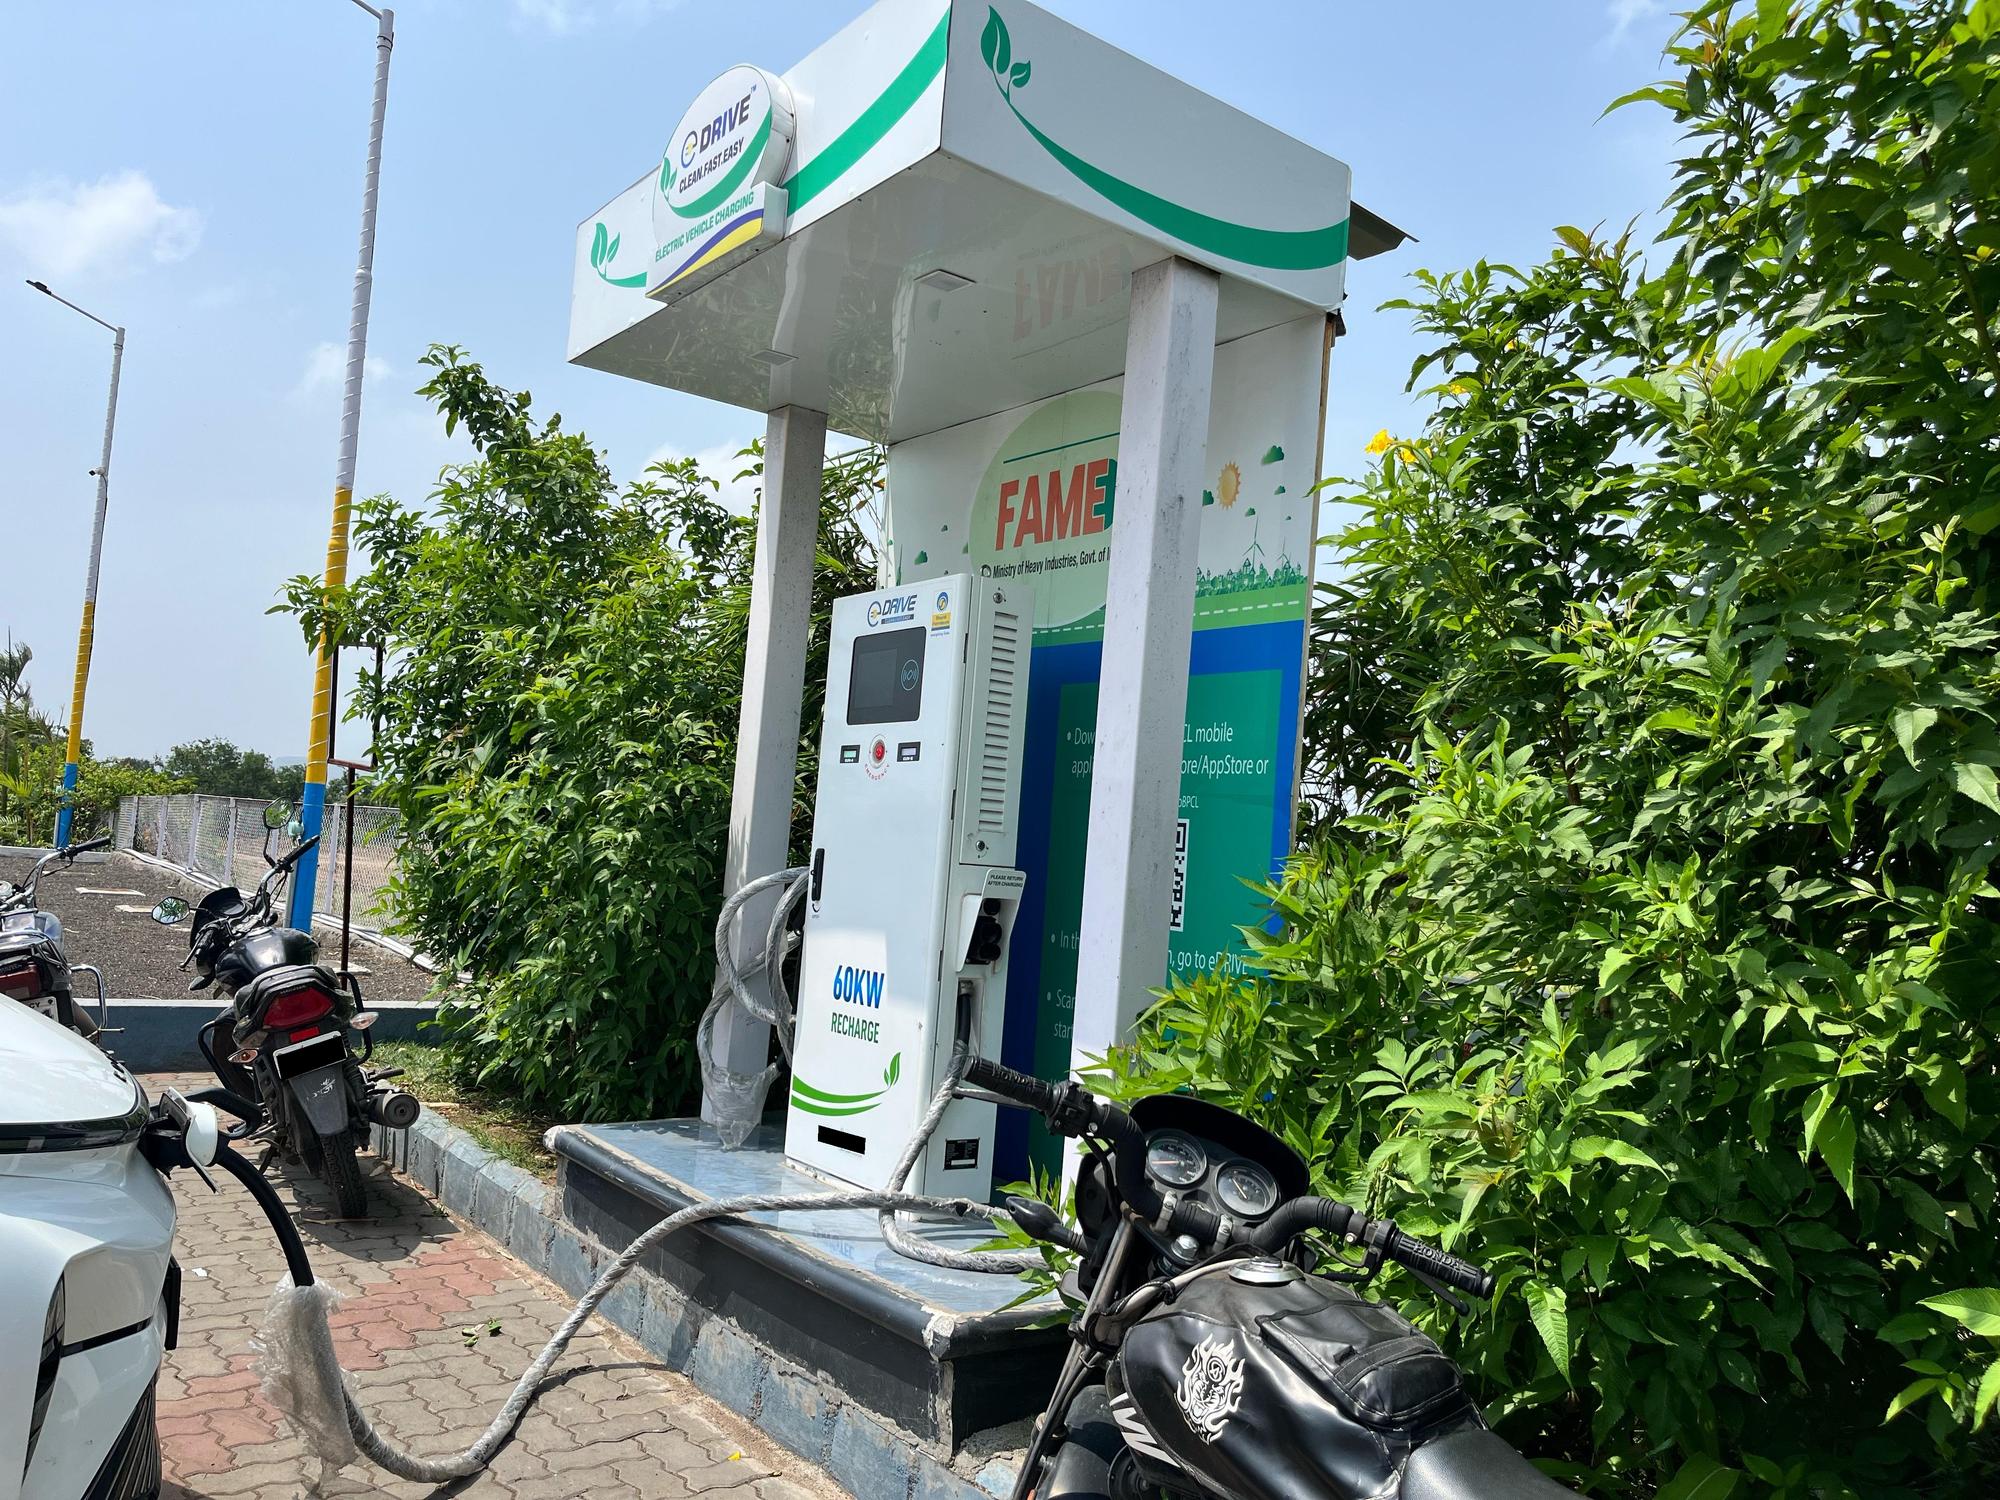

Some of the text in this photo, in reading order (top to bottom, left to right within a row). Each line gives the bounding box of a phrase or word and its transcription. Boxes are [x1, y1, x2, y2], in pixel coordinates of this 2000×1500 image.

[700, 94, 751, 154] DRIVE
[679, 136, 745, 194] CLEAN.FAST.EASY
[655, 192, 755, 262] ELECTRIC VEHICLE CHARGING
[995, 458, 1109, 551] FAME
[992, 563, 1016, 579] Ministry
[1017, 560, 1025, 575] of
[1025, 559, 1044, 575] Heavy
[1044, 554, 1078, 571] Industries,
[1080, 549, 1096, 566] Govt.
[1098, 546, 1106, 562] of
[882, 594, 917, 616] DRIVE
[1195, 721, 1233, 742] mobile
[1181, 754, 1254, 779] ore/AppStore
[1256, 759, 1269, 774] or
[1060, 930, 1069, 949] In
[1177, 951, 1192, 971] go
[1194, 950, 1206, 969] to
[833, 964, 885, 1009] 60KW
[830, 1012, 880, 1043] RECHARGE
[1413, 1242, 1463, 1271] HONDA
